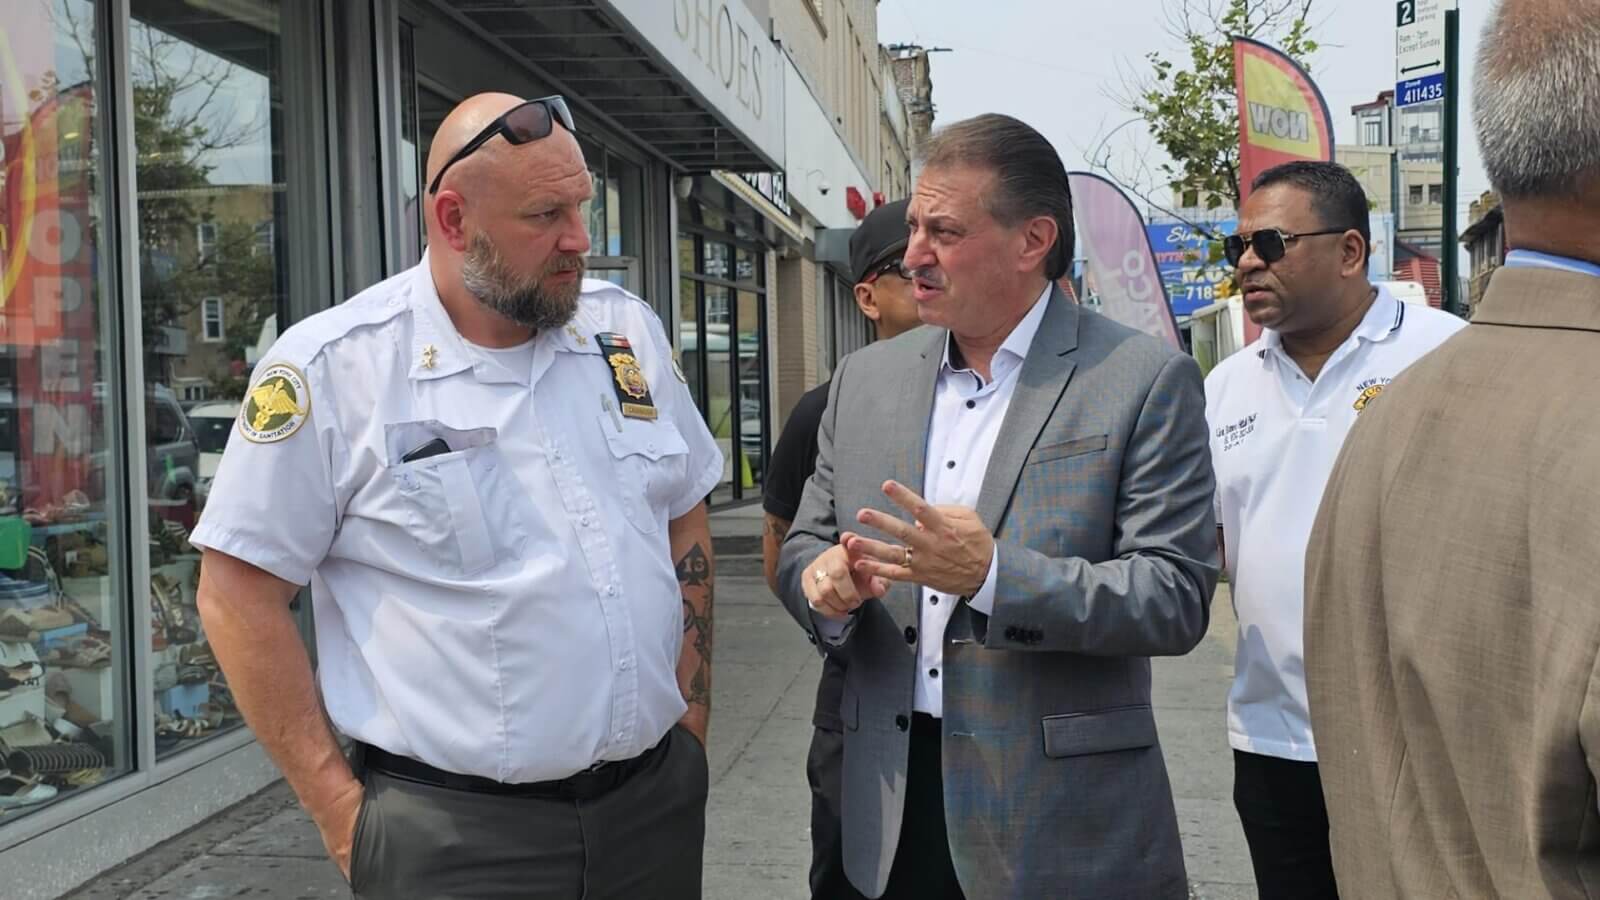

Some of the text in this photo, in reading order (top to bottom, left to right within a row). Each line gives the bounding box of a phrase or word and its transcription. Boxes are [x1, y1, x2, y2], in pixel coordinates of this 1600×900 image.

[1401, 2, 1413, 24] 2
[1419, 38, 1441, 49] Sunday
[1404, 83, 1443, 104] 411435
[1185, 286, 1213, 300] 718
[28, 208, 85, 455] OPEN
[1356, 377, 1377, 391] NEW
[684, 558, 705, 573] 13
